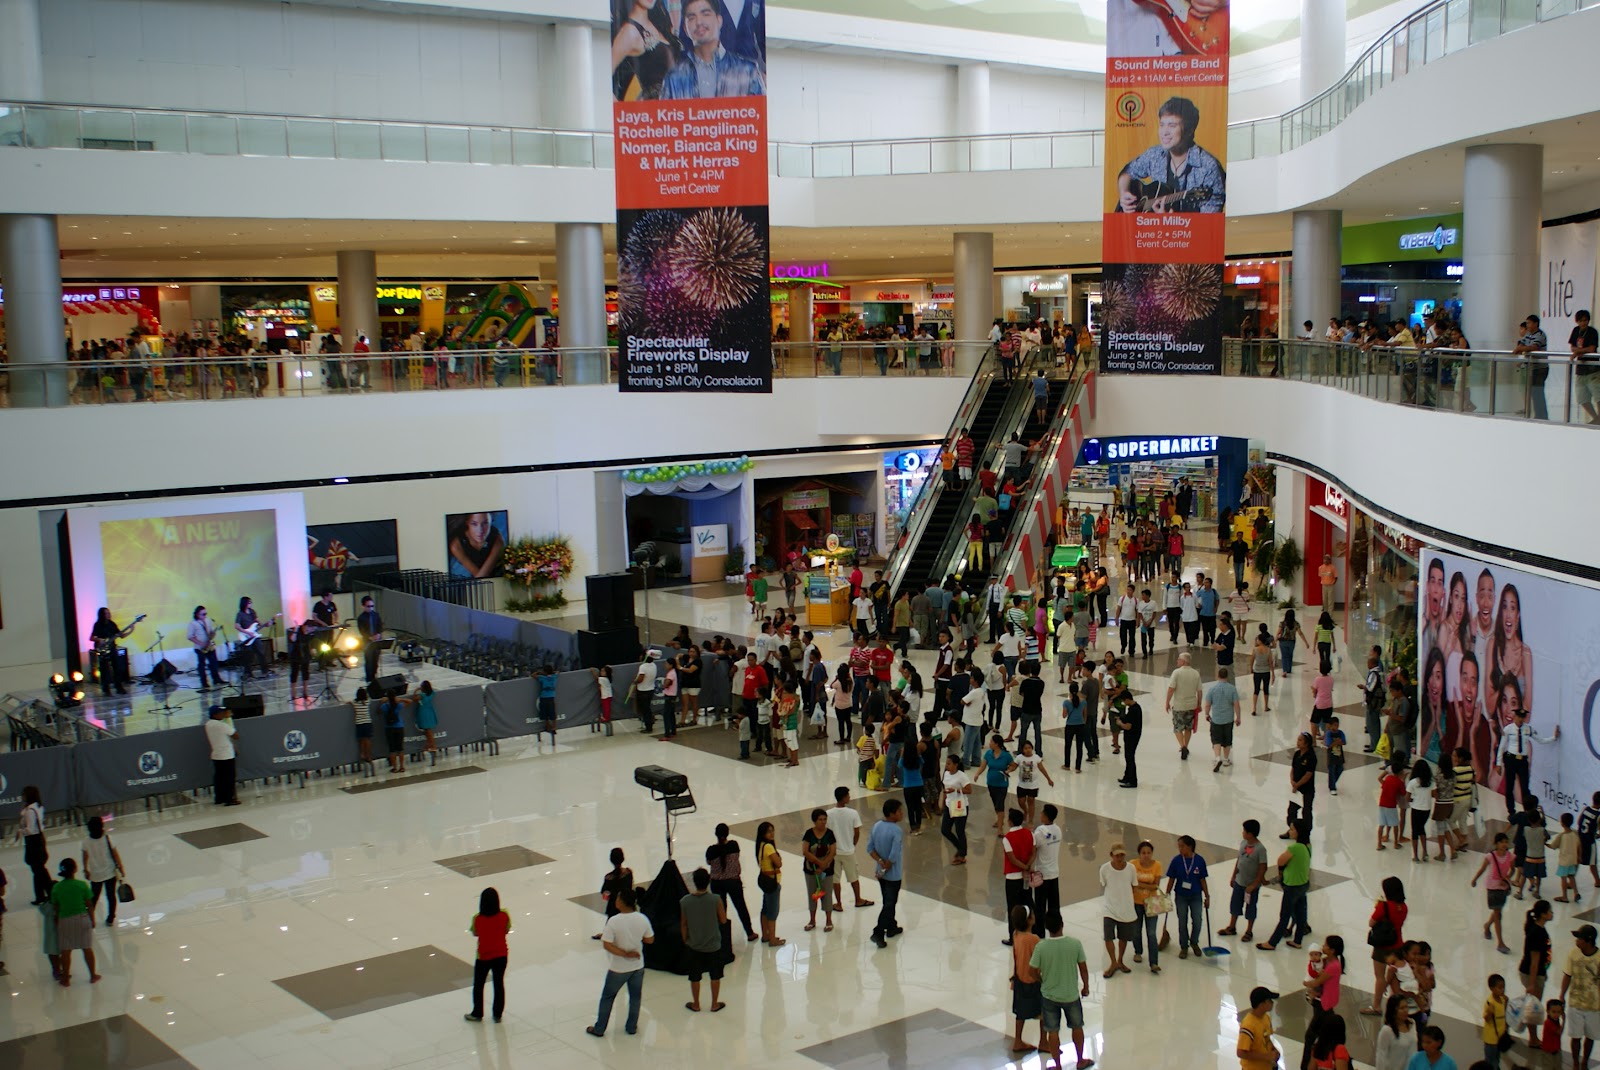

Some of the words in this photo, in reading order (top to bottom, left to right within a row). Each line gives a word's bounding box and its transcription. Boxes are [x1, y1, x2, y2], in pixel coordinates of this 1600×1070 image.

[1114, 60, 1150, 70] Sound
[1152, 59, 1188, 71] Merge
[1190, 58, 1220, 68] Band
[1110, 75, 1128, 84] June
[1130, 74, 1136, 82] 2
[1144, 74, 1166, 82] 11AM
[1174, 74, 1197, 82] Event
[1198, 74, 1224, 82] Center
[617, 110, 653, 126] Jaya,
[657, 109, 684, 122] Kris
[688, 108, 760, 120] Lawrence,
[619, 124, 679, 138] Rochelle
[683, 122, 759, 138] Pangilinan,
[622, 142, 671, 156] Nomer,
[674, 140, 722, 153] Bianca
[725, 138, 758, 153] King
[640, 158, 650, 170] &
[654, 156, 689, 168] Mark
[692, 155, 740, 168] Herras
[655, 172, 681, 182] June
[684, 171, 689, 181] 1
[700, 170, 724, 180] 4PM
[660, 184, 686, 194] Event
[688, 184, 720, 194] Center
[1136, 216, 1160, 226] Sam
[1162, 216, 1191, 228] Milby
[1135, 231, 1155, 239] June
[1136, 240, 1160, 248] Event
[1161, 240, 1190, 248] Center
[774, 262, 829, 278] court
[396, 287, 422, 300] FUN
[626, 336, 710, 350] Spectacular
[1108, 331, 1173, 342] Spectacular
[1108, 341, 1161, 350] Fireworks
[1164, 342, 1204, 353] Display
[627, 348, 696, 362] Fireworks
[700, 348, 750, 363] Display
[1108, 352, 1128, 360] June
[1129, 352, 1135, 360] 2
[1144, 352, 1164, 360] 8PM
[627, 363, 653, 374] June
[656, 364, 662, 373] 1
[674, 363, 698, 374] 8PM
[1108, 361, 1135, 370] fronting
[1136, 361, 1150, 370] SM
[1150, 361, 1166, 371] City
[1167, 362, 1214, 370] Consolacion
[628, 376, 664, 388] fronting
[664, 376, 682, 386] SM
[684, 375, 702, 388] City
[704, 376, 762, 386] Consolacion
[1108, 436, 1219, 458] SUPERMARKET
[164, 524, 181, 545] A
[185, 520, 240, 543] NEW
[272, 752, 320, 764] SUPERMALLS
[127, 773, 177, 786] SUPERMALLS
[1542, 780, 1579, 812] There's
